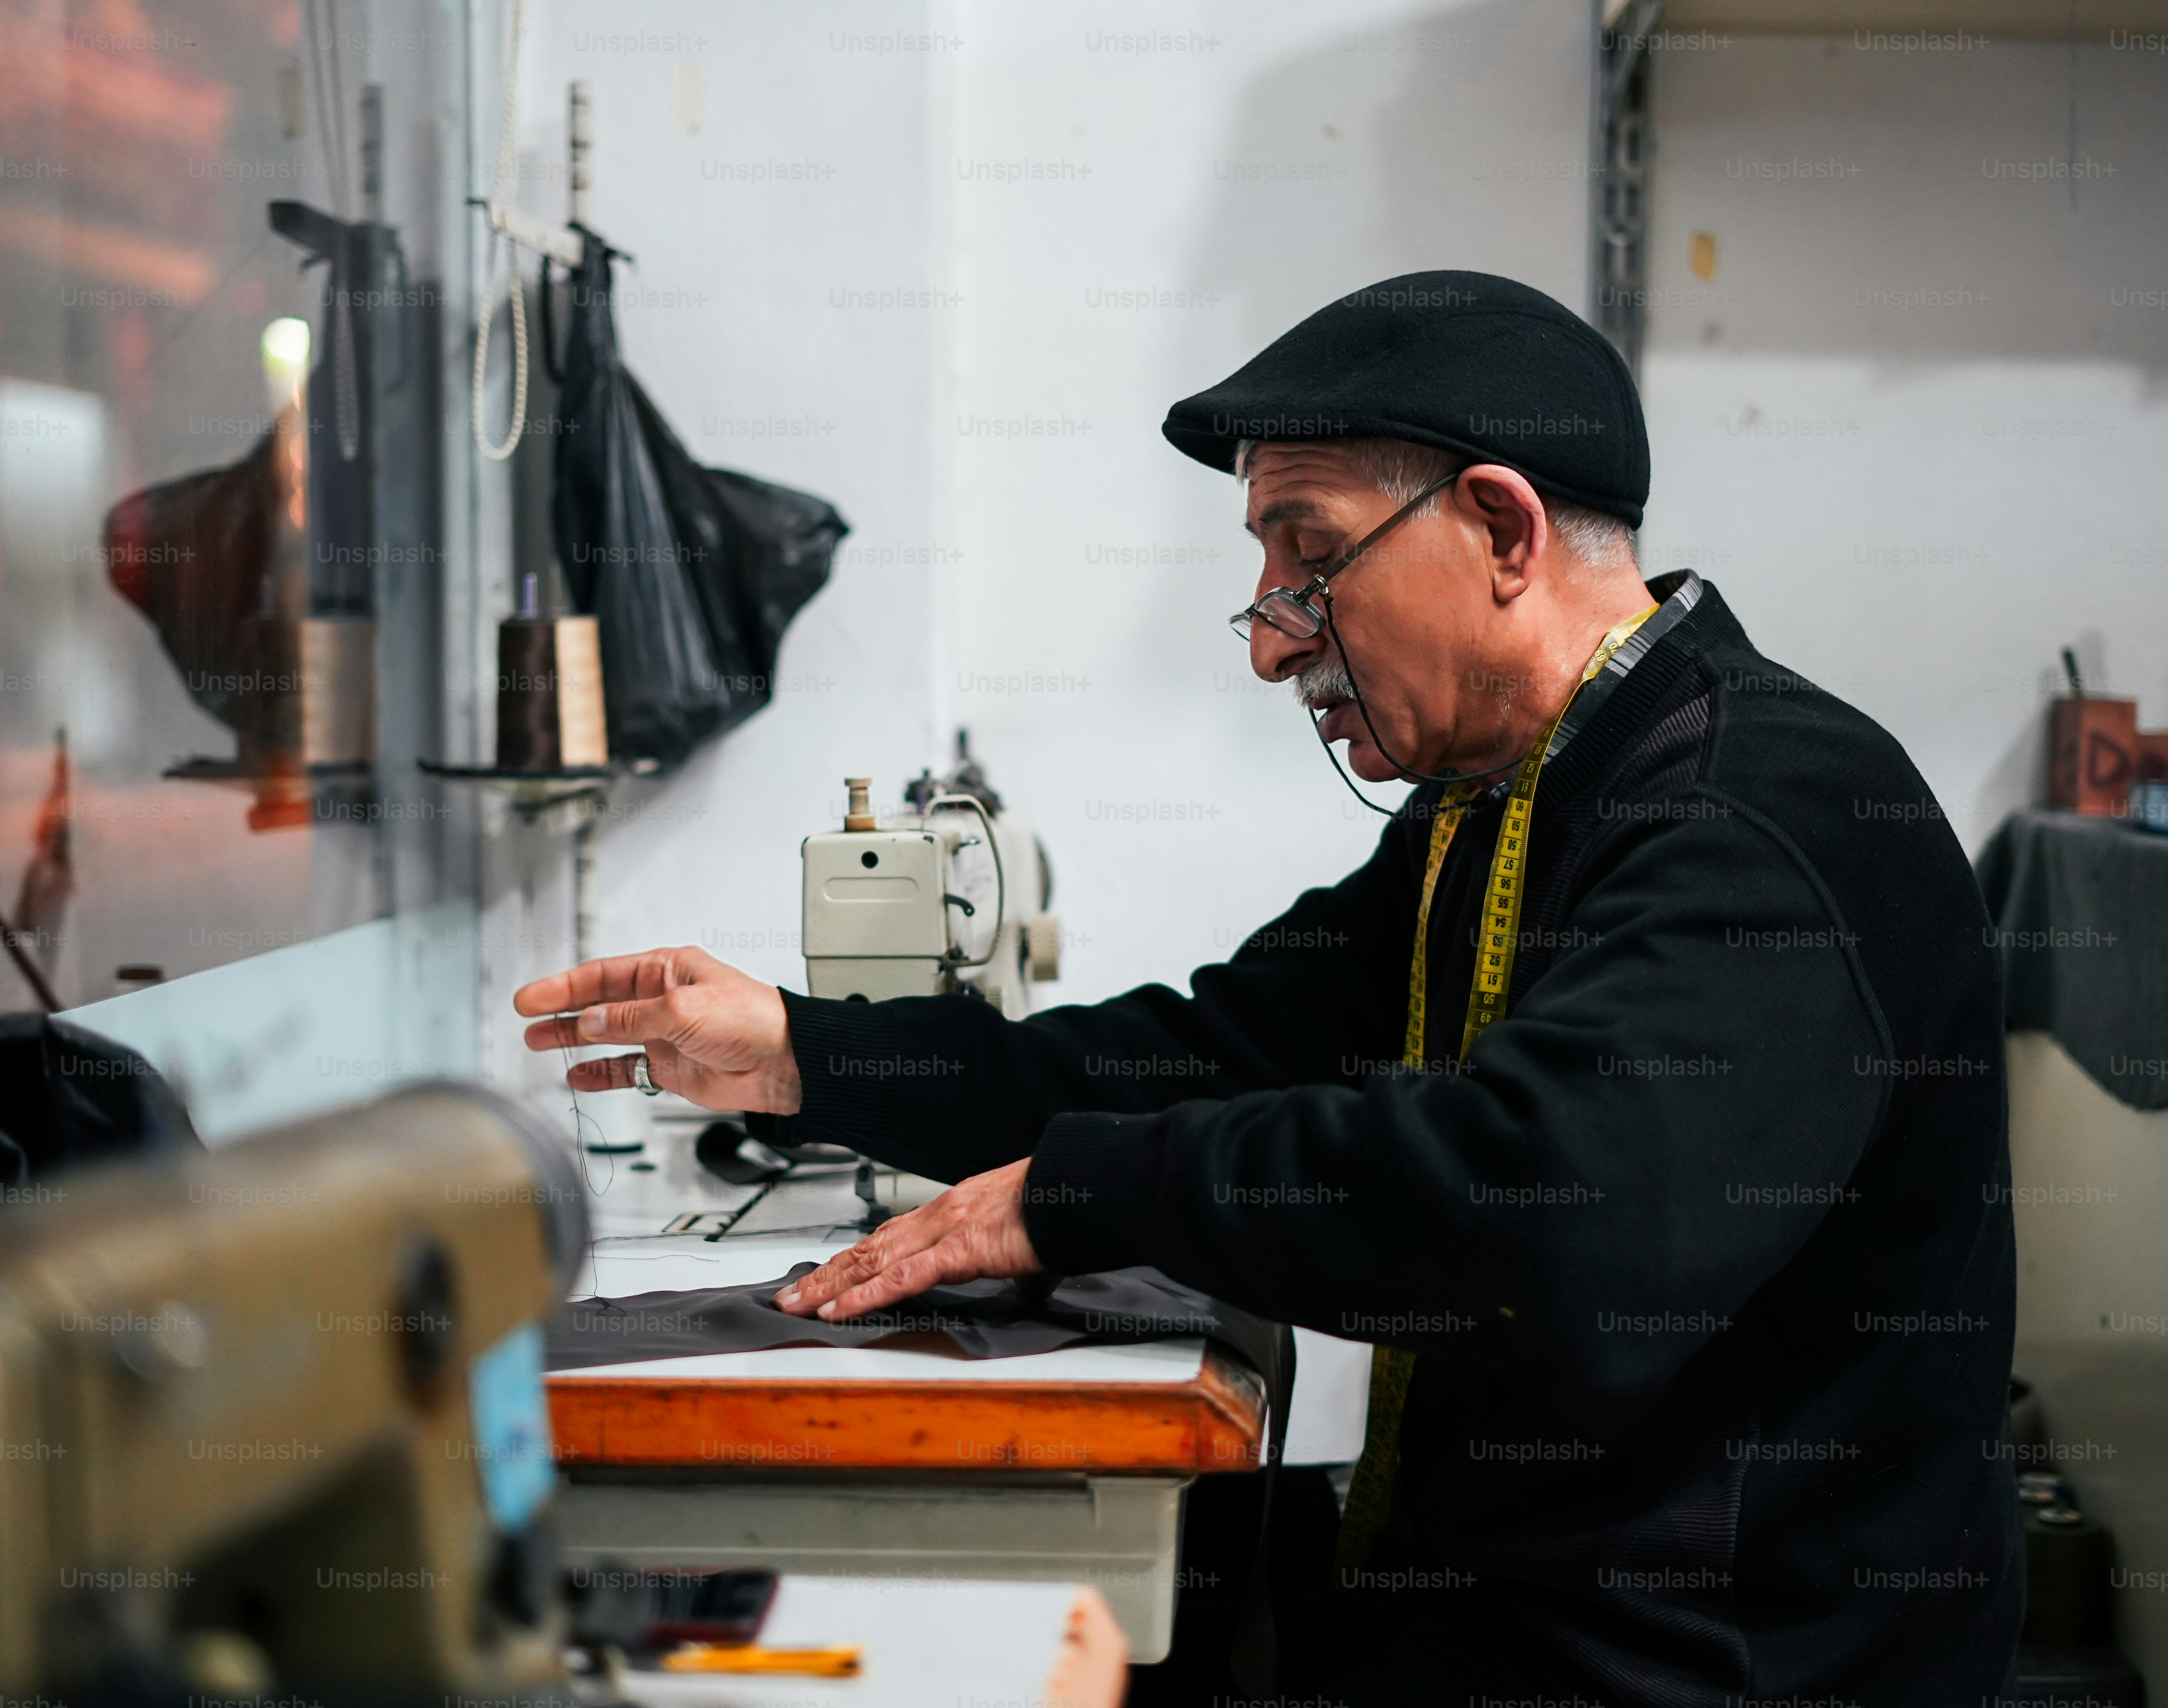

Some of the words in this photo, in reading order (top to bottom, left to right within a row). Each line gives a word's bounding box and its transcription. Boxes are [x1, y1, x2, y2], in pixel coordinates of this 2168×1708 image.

[1516, 800, 1524, 812] 60
[1507, 839, 1517, 851] 58
[1503, 859, 1514, 870] 57
[1501, 878, 1511, 889] 56
[1498, 898, 1509, 908] 55
[1495, 917, 1506, 927] 54
[1492, 936, 1503, 947] 53
[1489, 955, 1500, 966] 52
[1487, 975, 1498, 985] 51
[1484, 993, 1495, 1004] 50
[1480, 1012, 1491, 1023] 49
